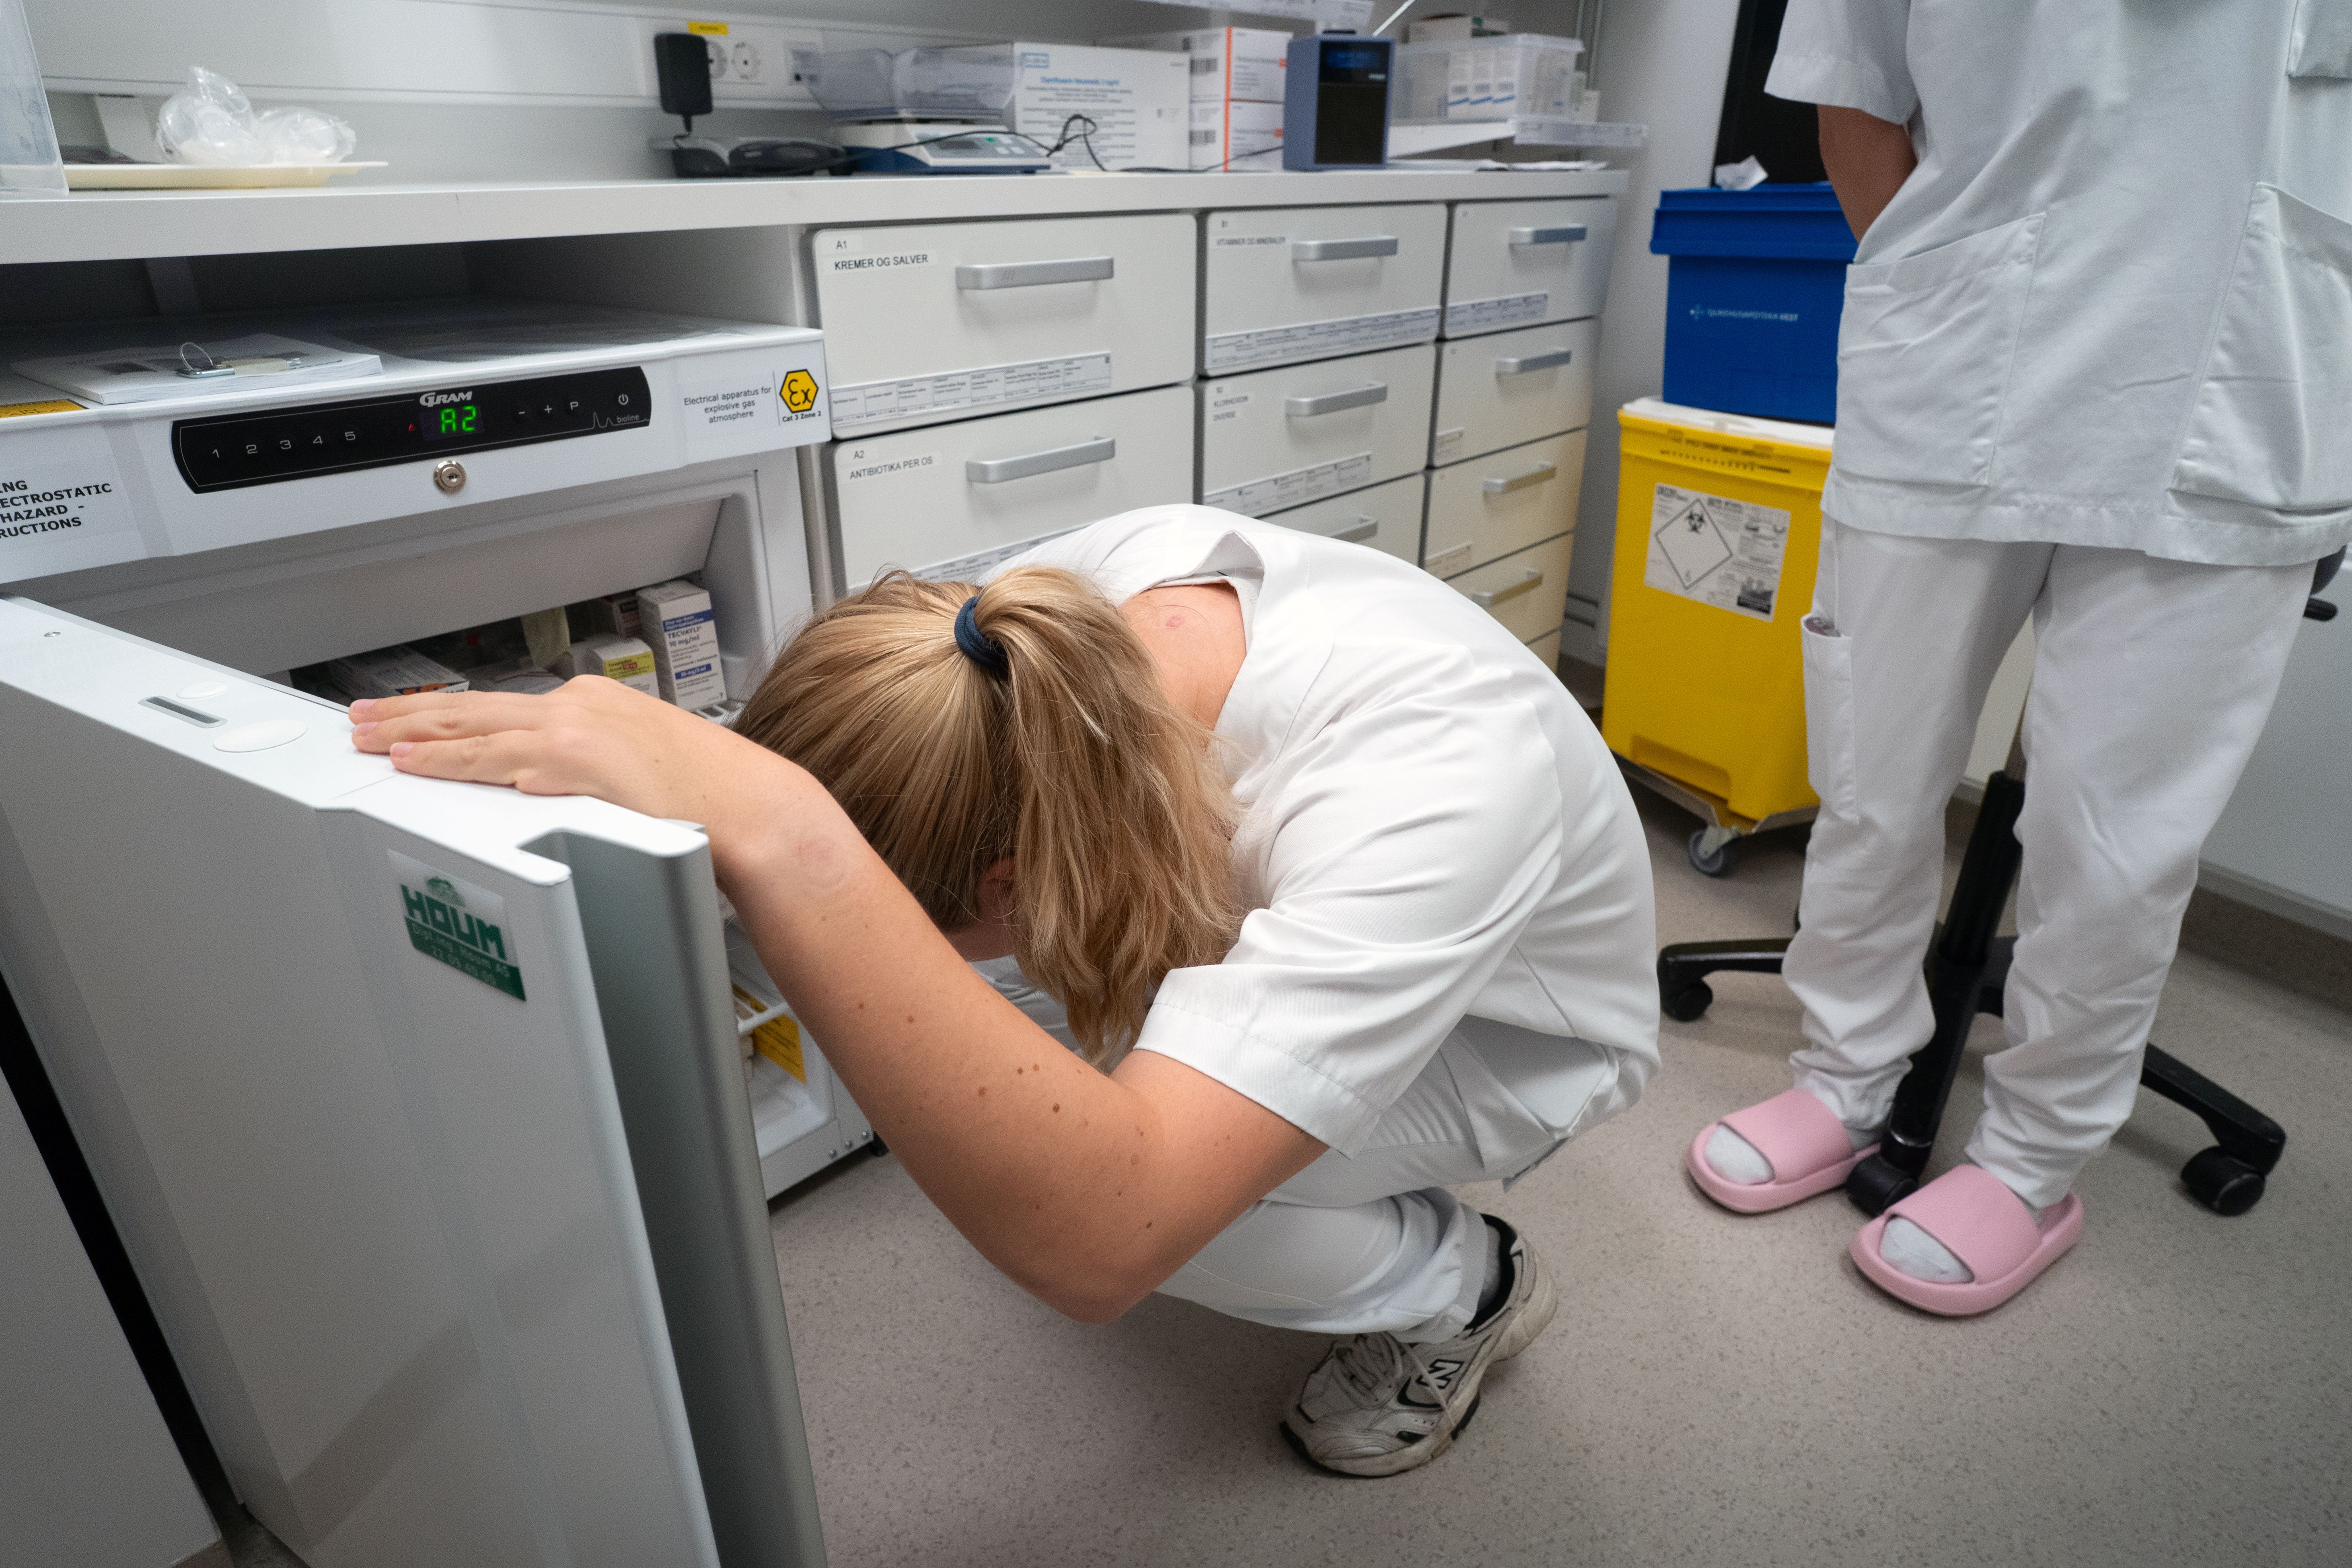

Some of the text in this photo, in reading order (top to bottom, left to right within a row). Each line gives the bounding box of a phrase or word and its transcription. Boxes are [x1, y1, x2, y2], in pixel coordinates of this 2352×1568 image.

[836, 240, 847, 249] A1
[835, 254, 928, 270] KREMER OG SALVER
[419, 391, 472, 407] GRAM
[684, 393, 719, 406] Electrical
[722, 388, 759, 401] apparatus
[705, 400, 756, 413] explosive gas
[440, 405, 477, 433] A2
[616, 413, 639, 423] bioline
[709, 410, 754, 423] atmosphere
[212, 431, 356, 458] 1 2 3 4 5
[853, 450, 865, 460] A2
[849, 456, 933, 480] ANTIBIOTIKA PER OS
[0, 505, 68, 523] HAZARD
[678, 635, 699, 645] mg/ml
